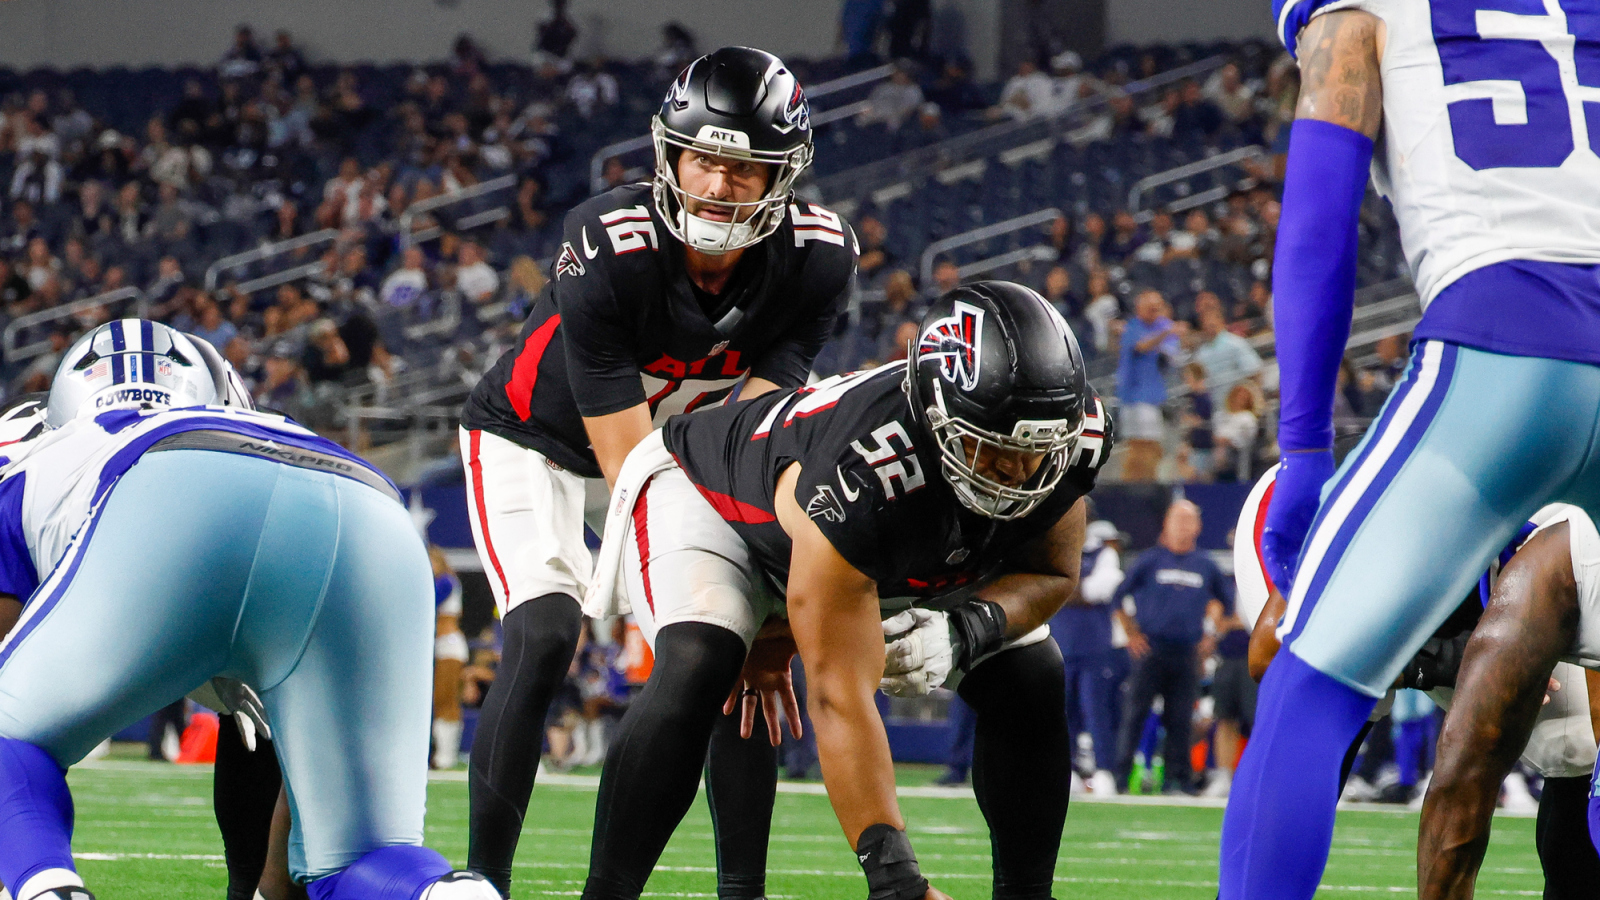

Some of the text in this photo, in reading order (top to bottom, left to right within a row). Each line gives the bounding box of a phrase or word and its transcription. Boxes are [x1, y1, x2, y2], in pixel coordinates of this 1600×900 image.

[1428, 0, 1600, 171] 5
[710, 129, 737, 143] ATL
[599, 204, 658, 255] 16
[299, 455, 353, 472] PRO
[850, 420, 926, 500] 52
